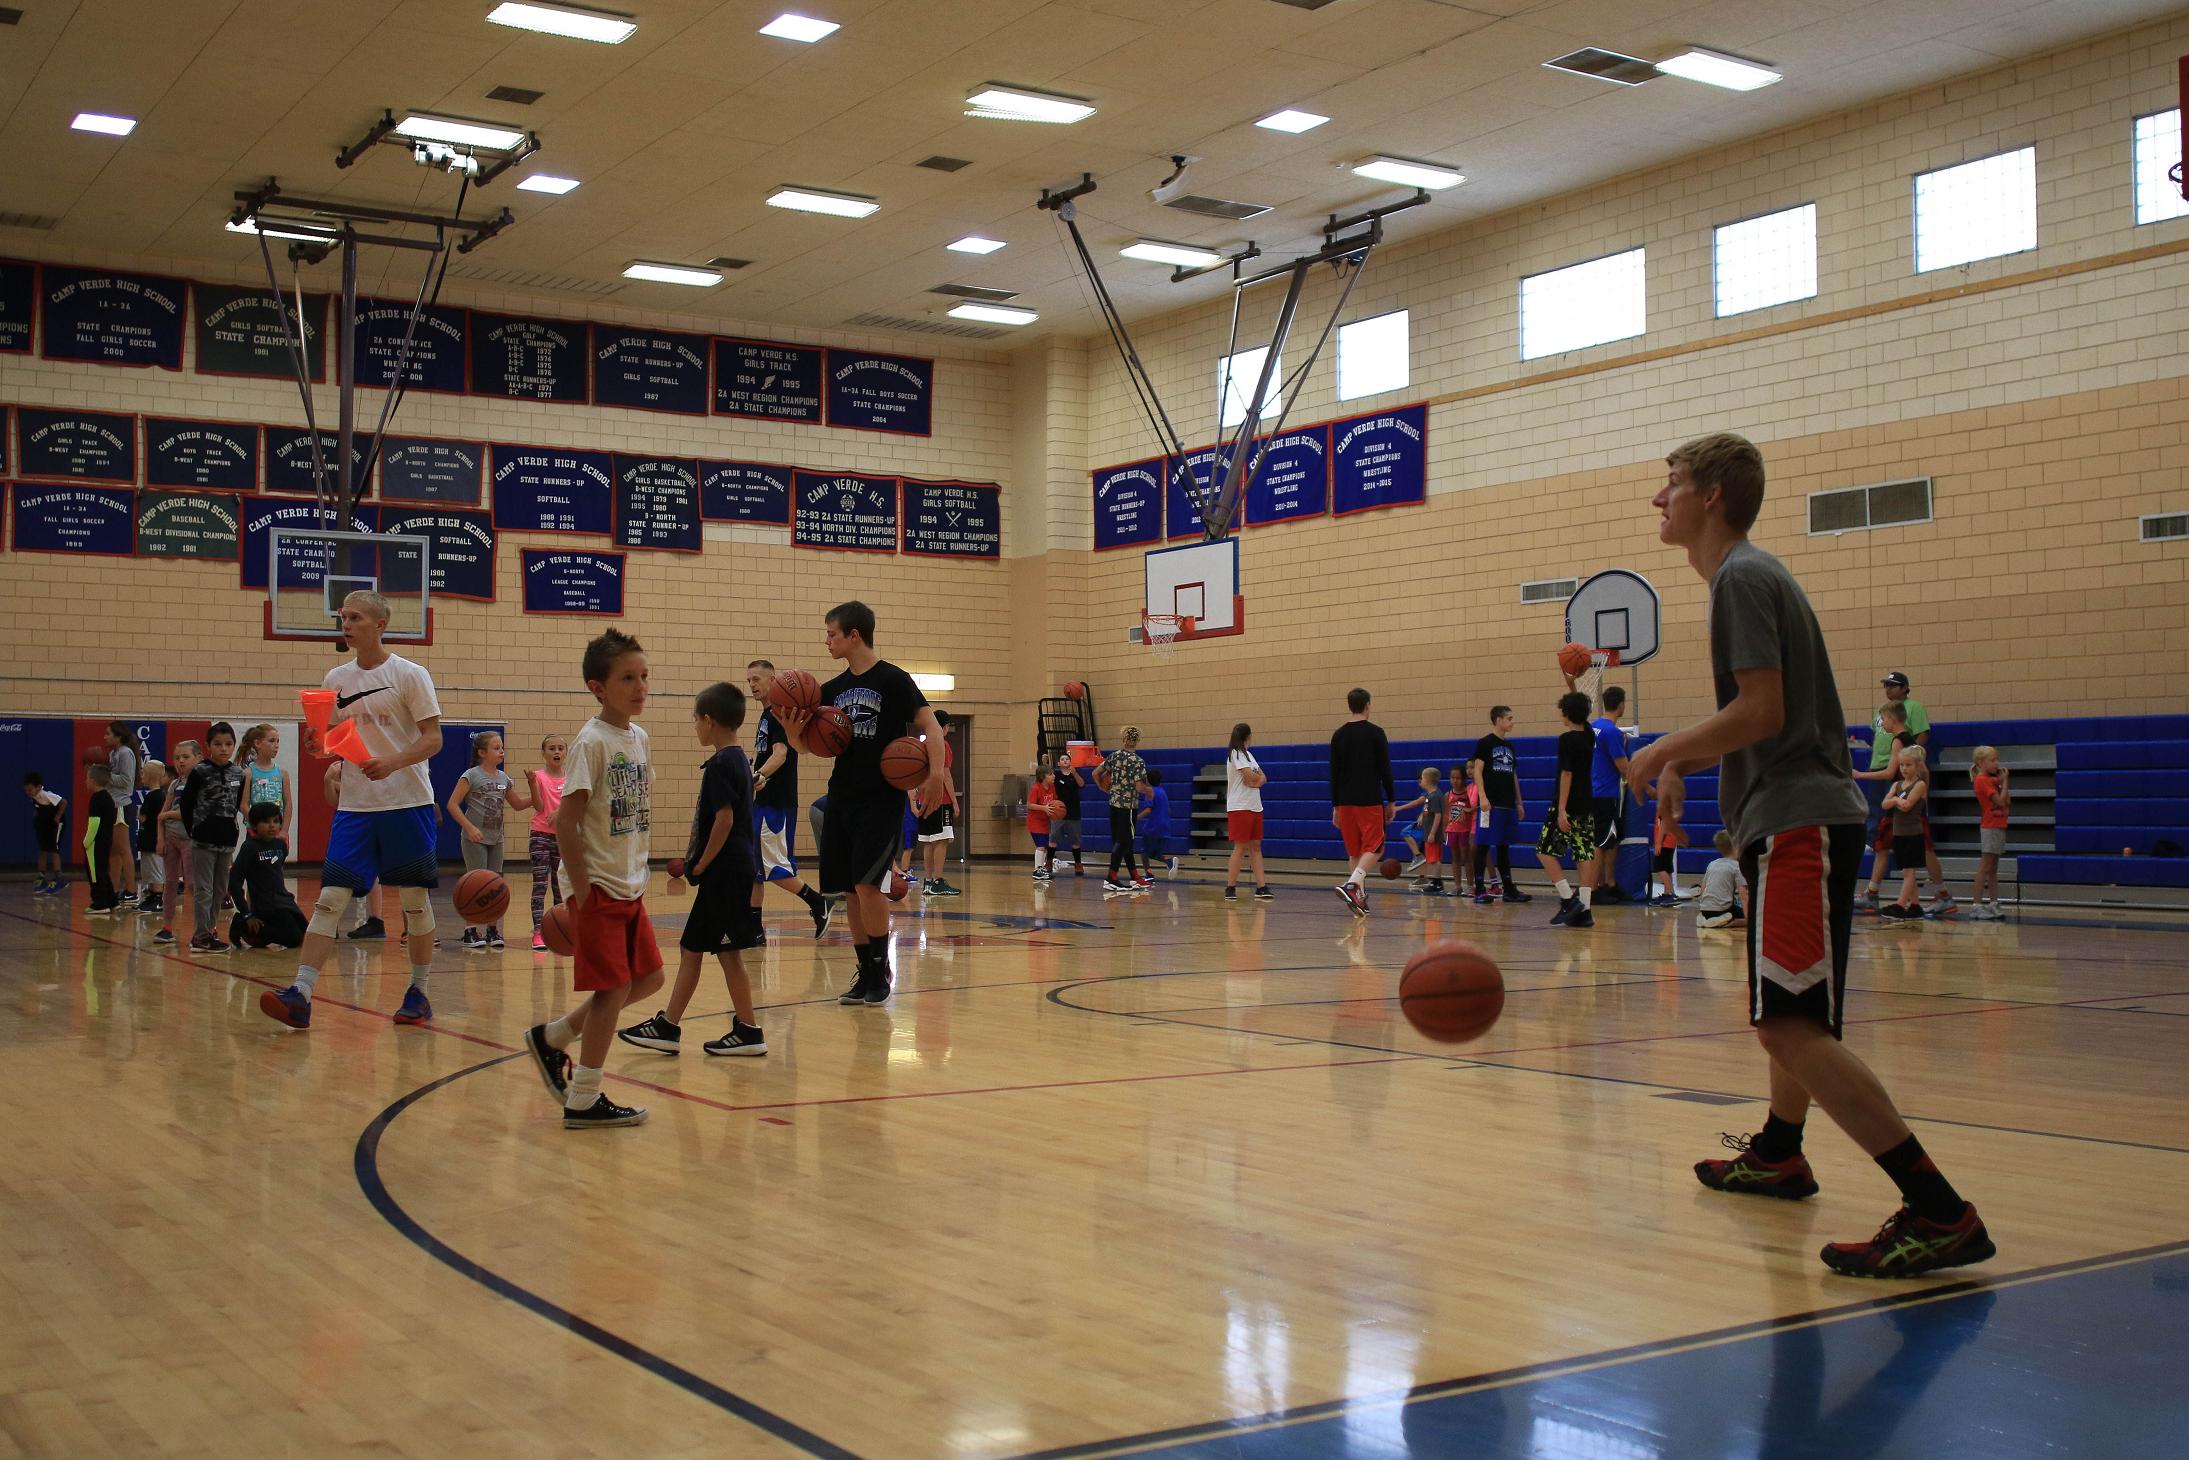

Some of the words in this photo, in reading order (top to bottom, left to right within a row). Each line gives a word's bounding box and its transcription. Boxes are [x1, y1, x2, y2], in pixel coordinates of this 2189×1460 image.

[51, 285, 76, 304] CAMP
[78, 279, 112, 290] VERDE
[116, 280, 140, 294] HIGH
[144, 288, 176, 314] SCHOOL
[205, 307, 226, 327] CAMP
[226, 298, 258, 312] VERDE
[77, 322, 100, 331] STATE
[111, 324, 152, 335] CHAMPIONS
[367, 309, 400, 320] VERDE
[429, 318, 464, 342] SCHOOL
[129, 339, 157, 348] SOCCER
[216, 330, 245, 342] STATE
[530, 324, 545, 334] HIGH
[546, 330, 568, 350] SCHOOL
[104, 347, 124, 356] 2000
[598, 343, 618, 359] CAMP
[620, 337, 646, 348] VERDE
[652, 340, 672, 350] HIGH
[676, 345, 704, 370] SCHOOL
[738, 347, 758, 356] CAMP
[760, 350, 783, 360] VERDE
[786, 352, 800, 361] H.S.
[620, 355, 640, 364] STATE
[744, 358, 765, 369] GIRLS
[770, 361, 792, 372] TRACK
[623, 372, 641, 381] GIRLS
[649, 376, 680, 386] SOFTBALL
[736, 374, 756, 384] 1994
[782, 380, 800, 389] 1995
[835, 364, 854, 380] CAMP
[854, 360, 880, 370] VERDE
[880, 362, 899, 372] HIGH
[899, 367, 924, 389] SCHOOL
[718, 388, 728, 398] 2A
[731, 390, 750, 400] WEST
[752, 392, 778, 403] REGION
[781, 395, 819, 406] CHAMPIONS
[862, 388, 877, 396] FALL
[880, 390, 894, 398] BOYS
[897, 392, 918, 400] SOCCER
[729, 401, 740, 410] 2A
[744, 402, 764, 412] STATE
[768, 406, 808, 416] CHAMPIONS
[852, 400, 872, 408] STATE
[874, 403, 906, 412] CHAMPIONS
[30, 427, 48, 443] CAMP
[50, 421, 75, 432] VERDE
[80, 422, 98, 433] HIGH
[100, 429, 125, 451] SCHOOL
[1337, 432, 1353, 454] CAMP
[1353, 421, 1375, 436] VERDE
[1377, 417, 1394, 428] HIGH
[1395, 419, 1420, 441] SCHOOL
[159, 437, 175, 452] CAMP
[177, 432, 200, 441] VERDE
[205, 432, 223, 443] HIGH
[225, 438, 247, 460] SCHOOL
[276, 442, 293, 458] CAMP
[321, 437, 338, 448] HIGH
[1285, 436, 1300, 446] HIGH
[1301, 435, 1323, 455] SCHOOL
[1364, 443, 1385, 453] DIVISION
[388, 450, 403, 464] CAMP
[408, 446, 429, 454] VERDE
[434, 447, 449, 455] HIGH
[454, 450, 475, 469] SCHOOL
[1355, 458, 1371, 467] STATE
[1372, 452, 1401, 463] CHAMPIONS
[495, 461, 515, 481] CAMP
[517, 456, 548, 467] VERDE
[554, 458, 576, 469] HIGH
[582, 463, 611, 488] SCHOOL
[1273, 460, 1292, 471] DIVISION
[1363, 466, 1392, 477] WRESTLING
[520, 476, 539, 484] STATE
[622, 468, 637, 482] CAMP
[638, 463, 658, 472] VERDE
[661, 463, 676, 472] HIGH
[677, 468, 697, 488] SCHOOL
[654, 478, 686, 487] BASKETBALL
[704, 473, 719, 487] CAMP
[747, 471, 761, 479] HIGH
[764, 475, 785, 492] SCHOOL
[1266, 476, 1281, 486] STATE
[1282, 471, 1306, 482] CHAMPIONS
[657, 487, 686, 495] CHAMPIONS
[1099, 480, 1110, 498] CAMP
[1140, 470, 1157, 488] SCHOOL
[537, 495, 570, 504] SOFTBALL
[807, 483, 829, 503] CAMP
[833, 479, 865, 494] VERDE
[869, 490, 885, 509] H.S.
[924, 488, 942, 497] CAMP
[944, 489, 964, 498] VERDE
[966, 491, 979, 499] H.S.
[21, 496, 42, 508] CAMP
[45, 492, 72, 503] VERDE
[75, 492, 96, 502] HIGH
[99, 496, 128, 514] SCHOOL
[923, 499, 942, 507] GIRLS
[945, 500, 976, 509] SOFTBALL
[138, 507, 158, 527] CAMP
[156, 498, 186, 512] VERDE
[189, 498, 210, 510] HIGH
[210, 504, 239, 534] SCHOOL
[171, 515, 205, 524] BASEBALL
[248, 513, 272, 533] CAMP
[275, 508, 309, 520] VERDE
[796, 509, 819, 519] 92-93
[821, 512, 831, 520] 2A
[833, 514, 852, 522] STATE
[855, 515, 895, 524] RUNNERS-UP
[920, 515, 937, 524] 1994
[967, 518, 984, 527] 1995
[165, 529, 200, 538] DIVISIONAL
[202, 531, 237, 541] CHAMPIONS
[404, 517, 434, 529] VERDE
[438, 518, 460, 528] HIGH
[463, 521, 493, 549] SCHOOL
[796, 521, 820, 530] 93-94
[822, 523, 845, 532] NORTH
[860, 526, 896, 535] CHAMPIONS
[906, 529, 916, 537] 2A
[919, 530, 935, 539] WEST
[938, 531, 960, 540] REGION
[964, 532, 998, 542] CHAMPIONS
[439, 536, 472, 545] SOFTBALL
[796, 532, 821, 542] 94-95
[824, 534, 834, 542] 2A
[838, 535, 856, 544] STATE
[859, 536, 896, 546] CHAMPIONS
[915, 540, 925, 548] 2A
[929, 541, 946, 550] STATE
[950, 542, 989, 551] RUNNERS-UP
[530, 560, 546, 573] CAMP
[549, 556, 572, 564] VERDE
[595, 561, 617, 577] SCHOOL
